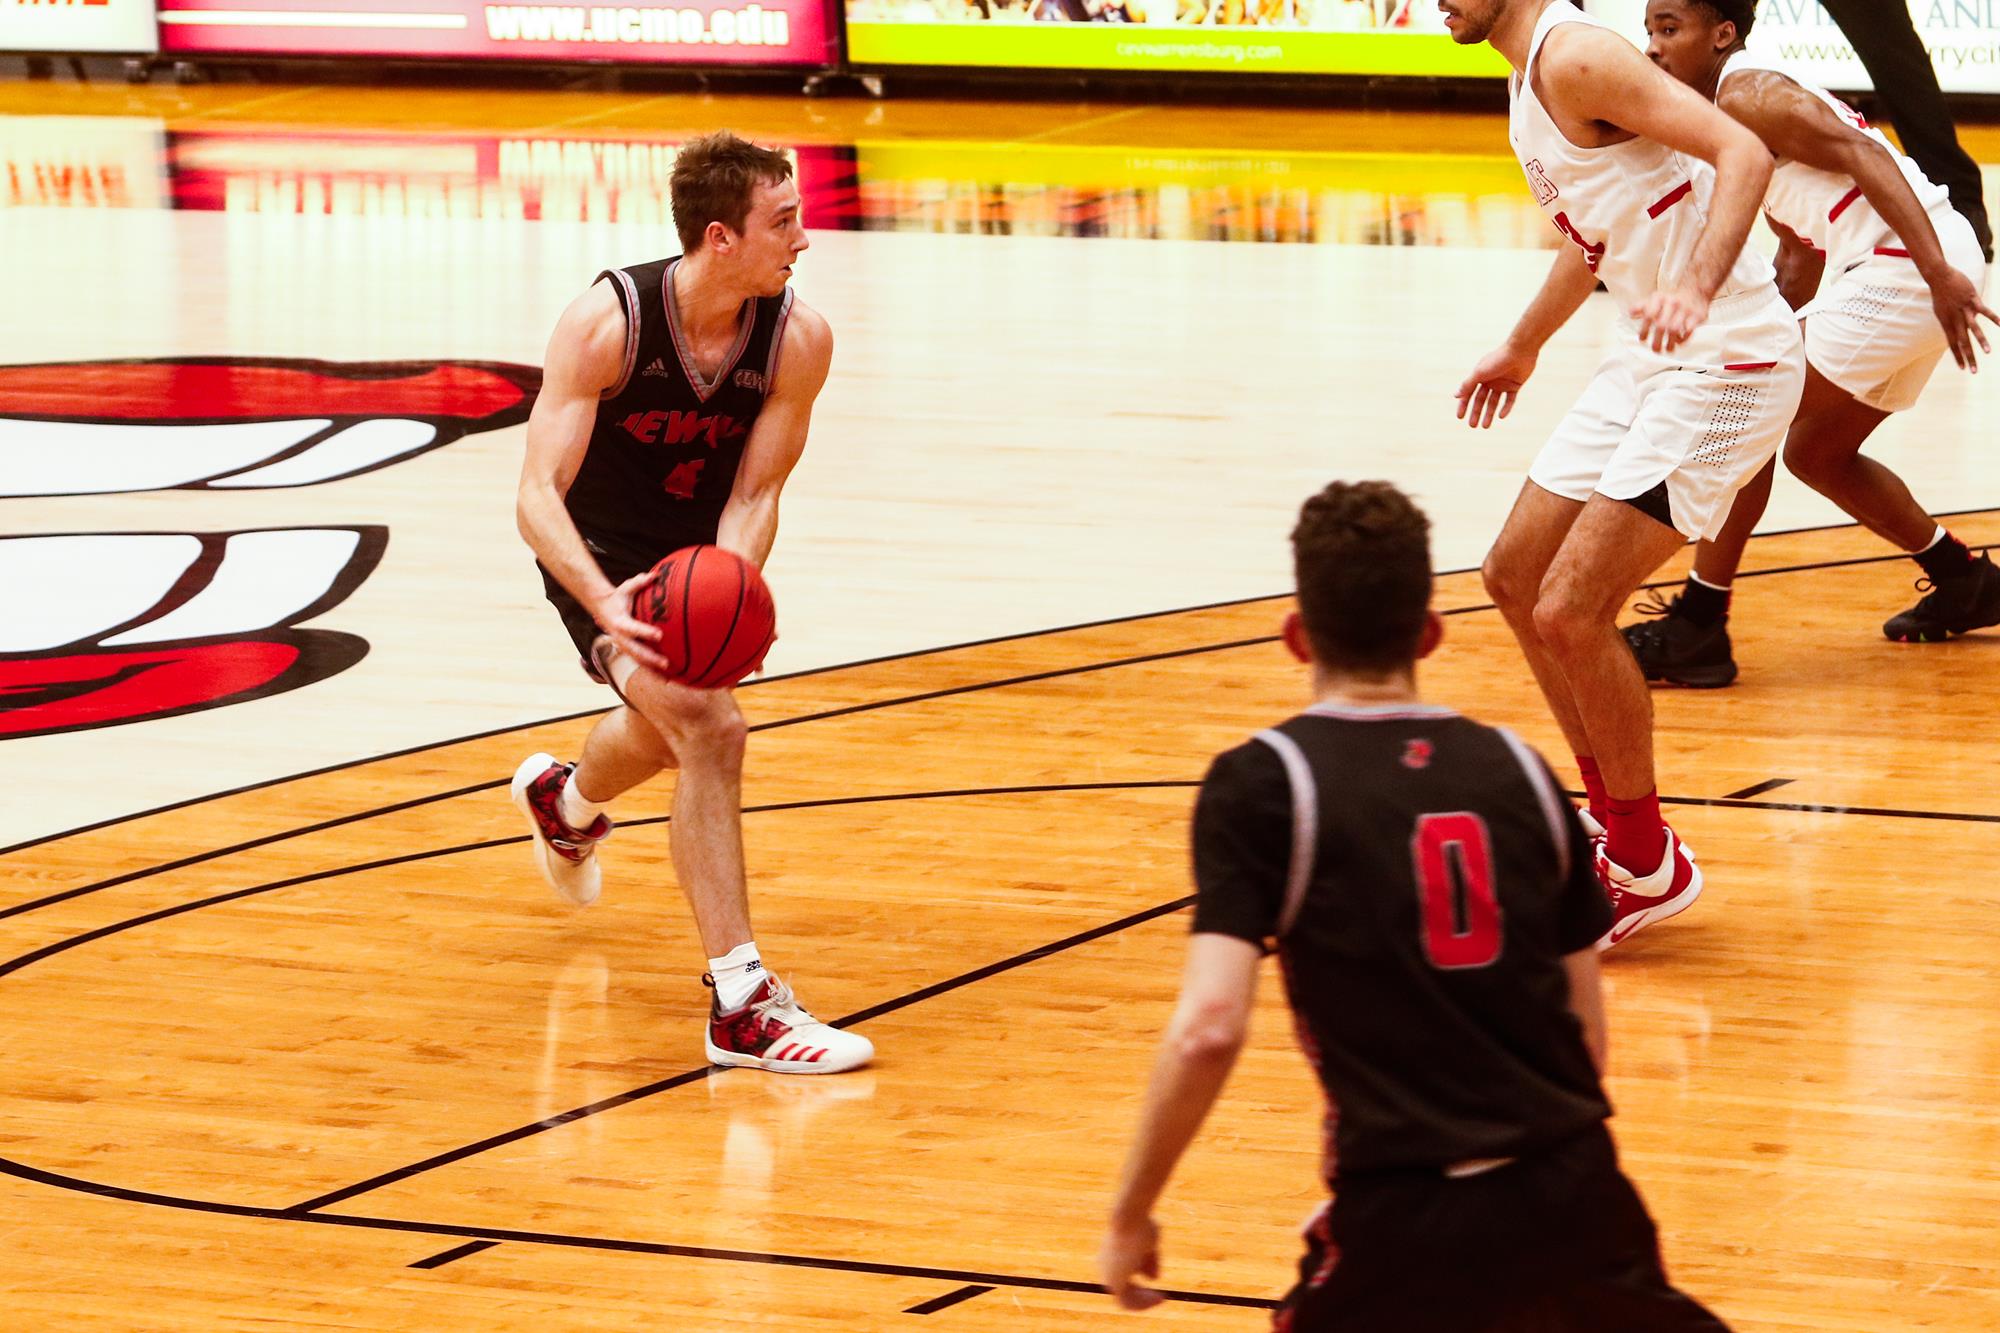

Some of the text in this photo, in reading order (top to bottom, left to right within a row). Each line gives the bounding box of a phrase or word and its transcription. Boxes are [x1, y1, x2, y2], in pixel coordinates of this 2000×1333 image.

[485, 4, 789, 46] www.ucmo.edu
[662, 459, 706, 500] 4
[1409, 810, 1504, 970] 0
